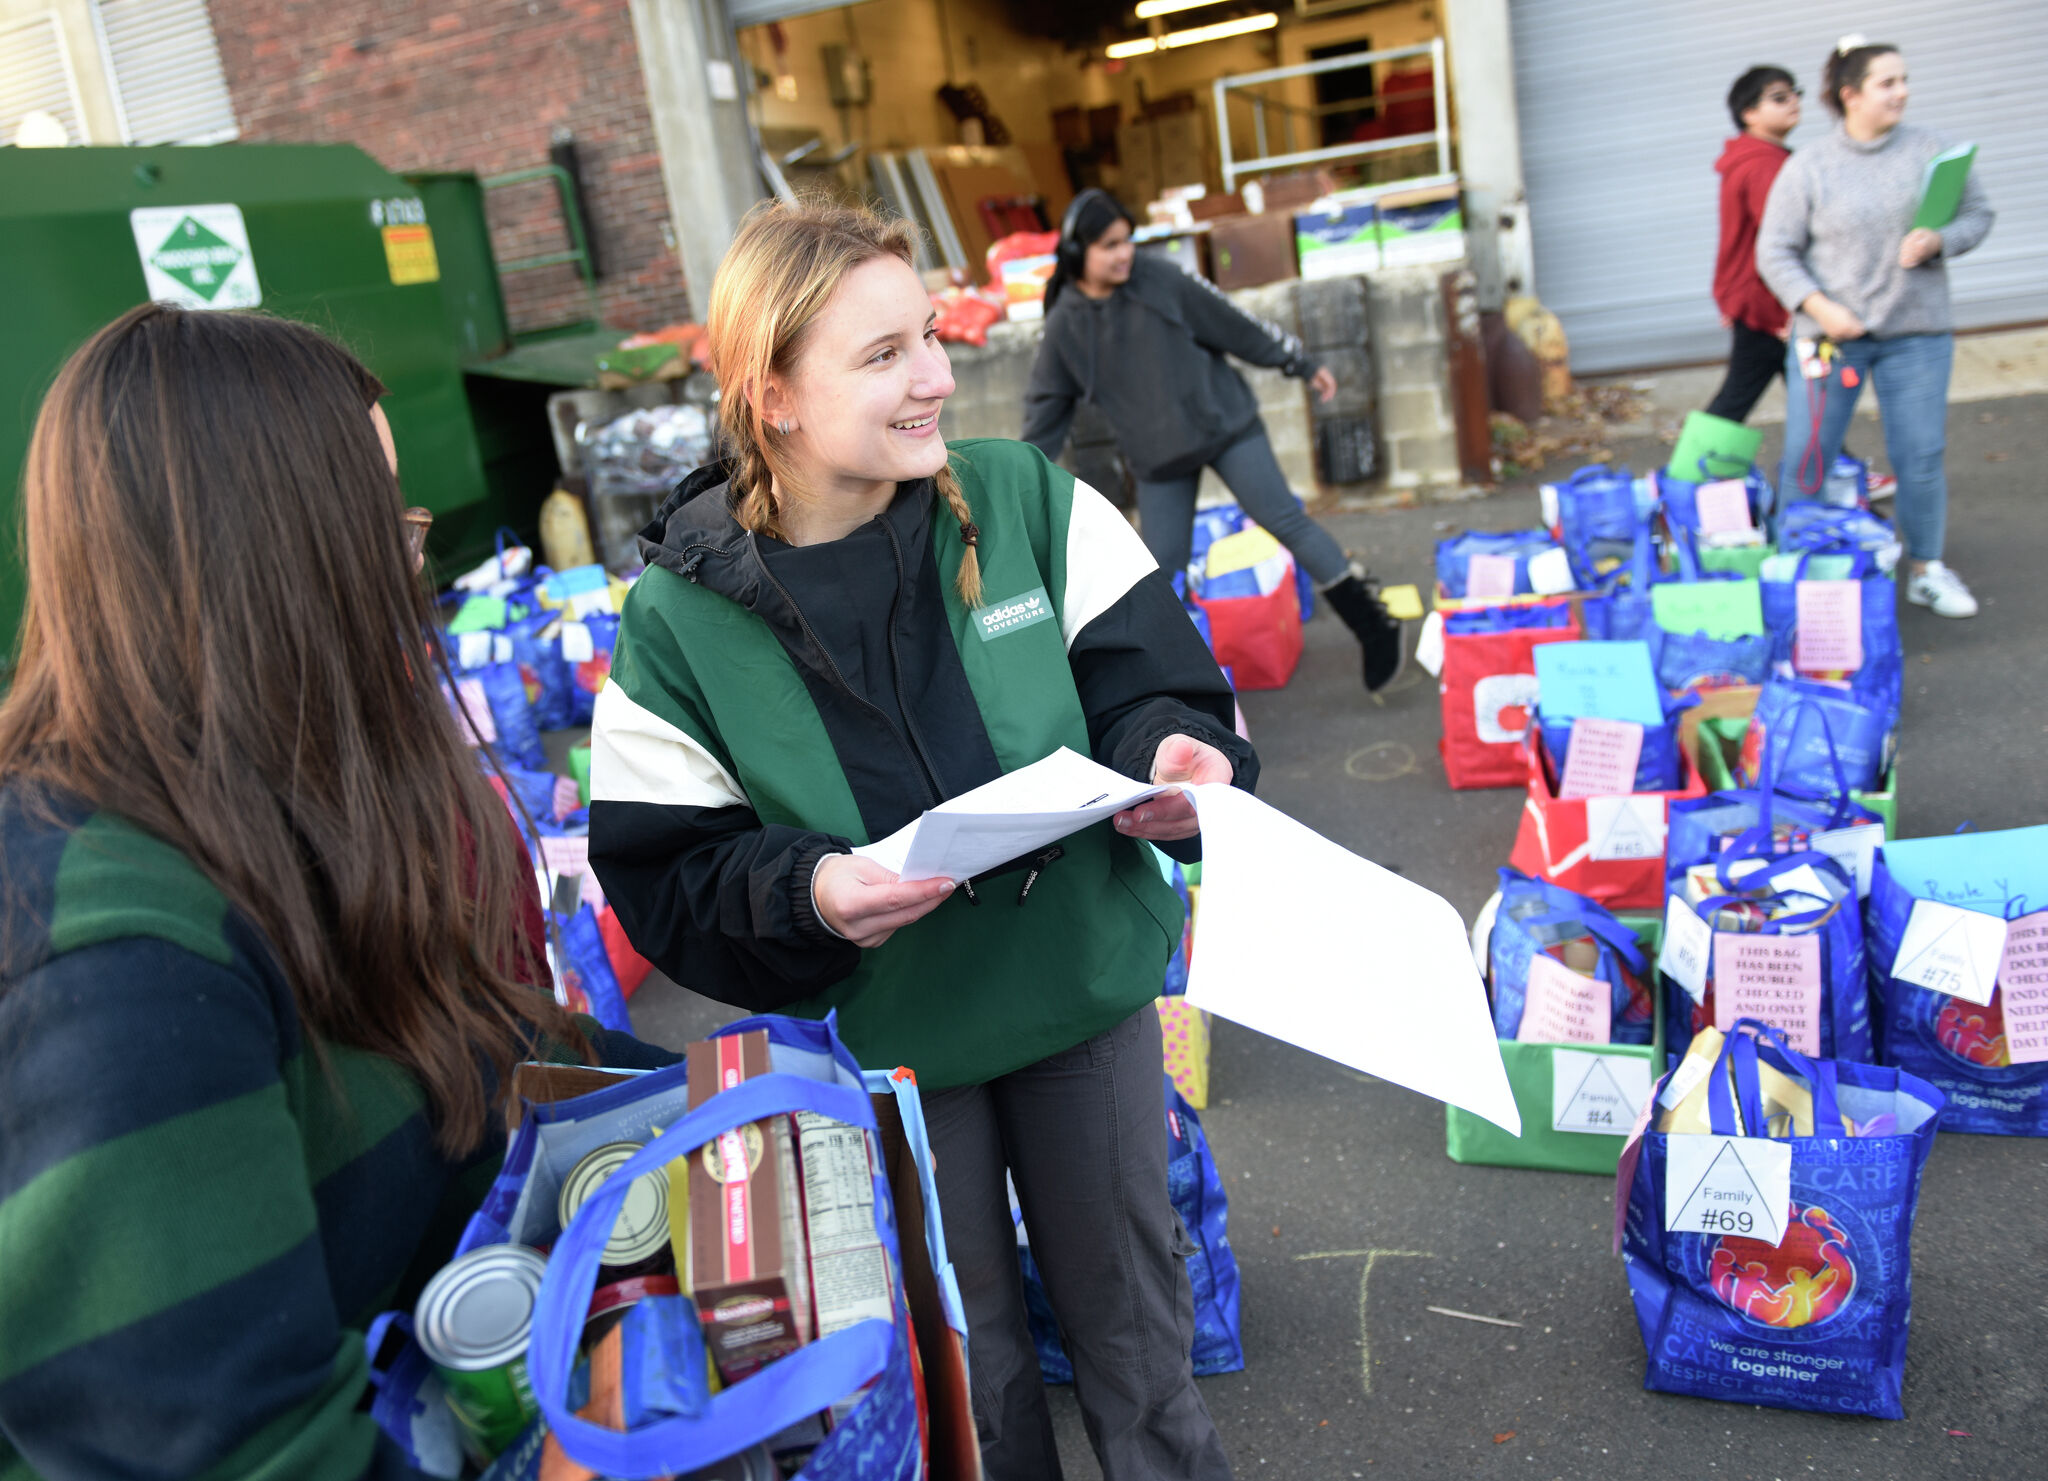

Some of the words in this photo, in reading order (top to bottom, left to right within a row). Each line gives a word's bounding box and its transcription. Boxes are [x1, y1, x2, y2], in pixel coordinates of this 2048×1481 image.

[983, 603, 1026, 626] adidas
[987, 607, 1045, 634] ADVENTURE
[2009, 927, 2038, 942] THIS
[1739, 946, 1770, 957] THIS
[1773, 948, 1801, 959] BAG
[1930, 947, 1967, 967] Family
[2007, 942, 2033, 957] HAS
[1735, 960, 1765, 971] HAS
[1767, 961, 1803, 972] BEEN
[1921, 966, 1962, 993] #75
[1735, 988, 1805, 999] CHECKED
[2009, 988, 2039, 1002] AND
[1735, 1002, 1765, 1013] AND
[1768, 1003, 1806, 1014] ONLY
[2013, 1036, 2040, 1050] DAY
[1581, 1091, 1619, 1107] Family
[1957, 1081, 1983, 1094] are
[1987, 1082, 2043, 1100] stronger
[1950, 1092, 2025, 1113] together
[1587, 1109, 1613, 1126] #4
[1791, 1138, 1905, 1153] STANDARDS
[1826, 1152, 1904, 1167] RESPECT
[1810, 1165, 1899, 1191] CARE
[1703, 1187, 1754, 1206] Family
[1701, 1208, 1754, 1233] #69
[1710, 1338, 1736, 1354] we
[1740, 1346, 1769, 1360] are
[1773, 1350, 1846, 1370] stronger
[1659, 1359, 1744, 1389] RESPECT
[1731, 1357, 1819, 1383] together
